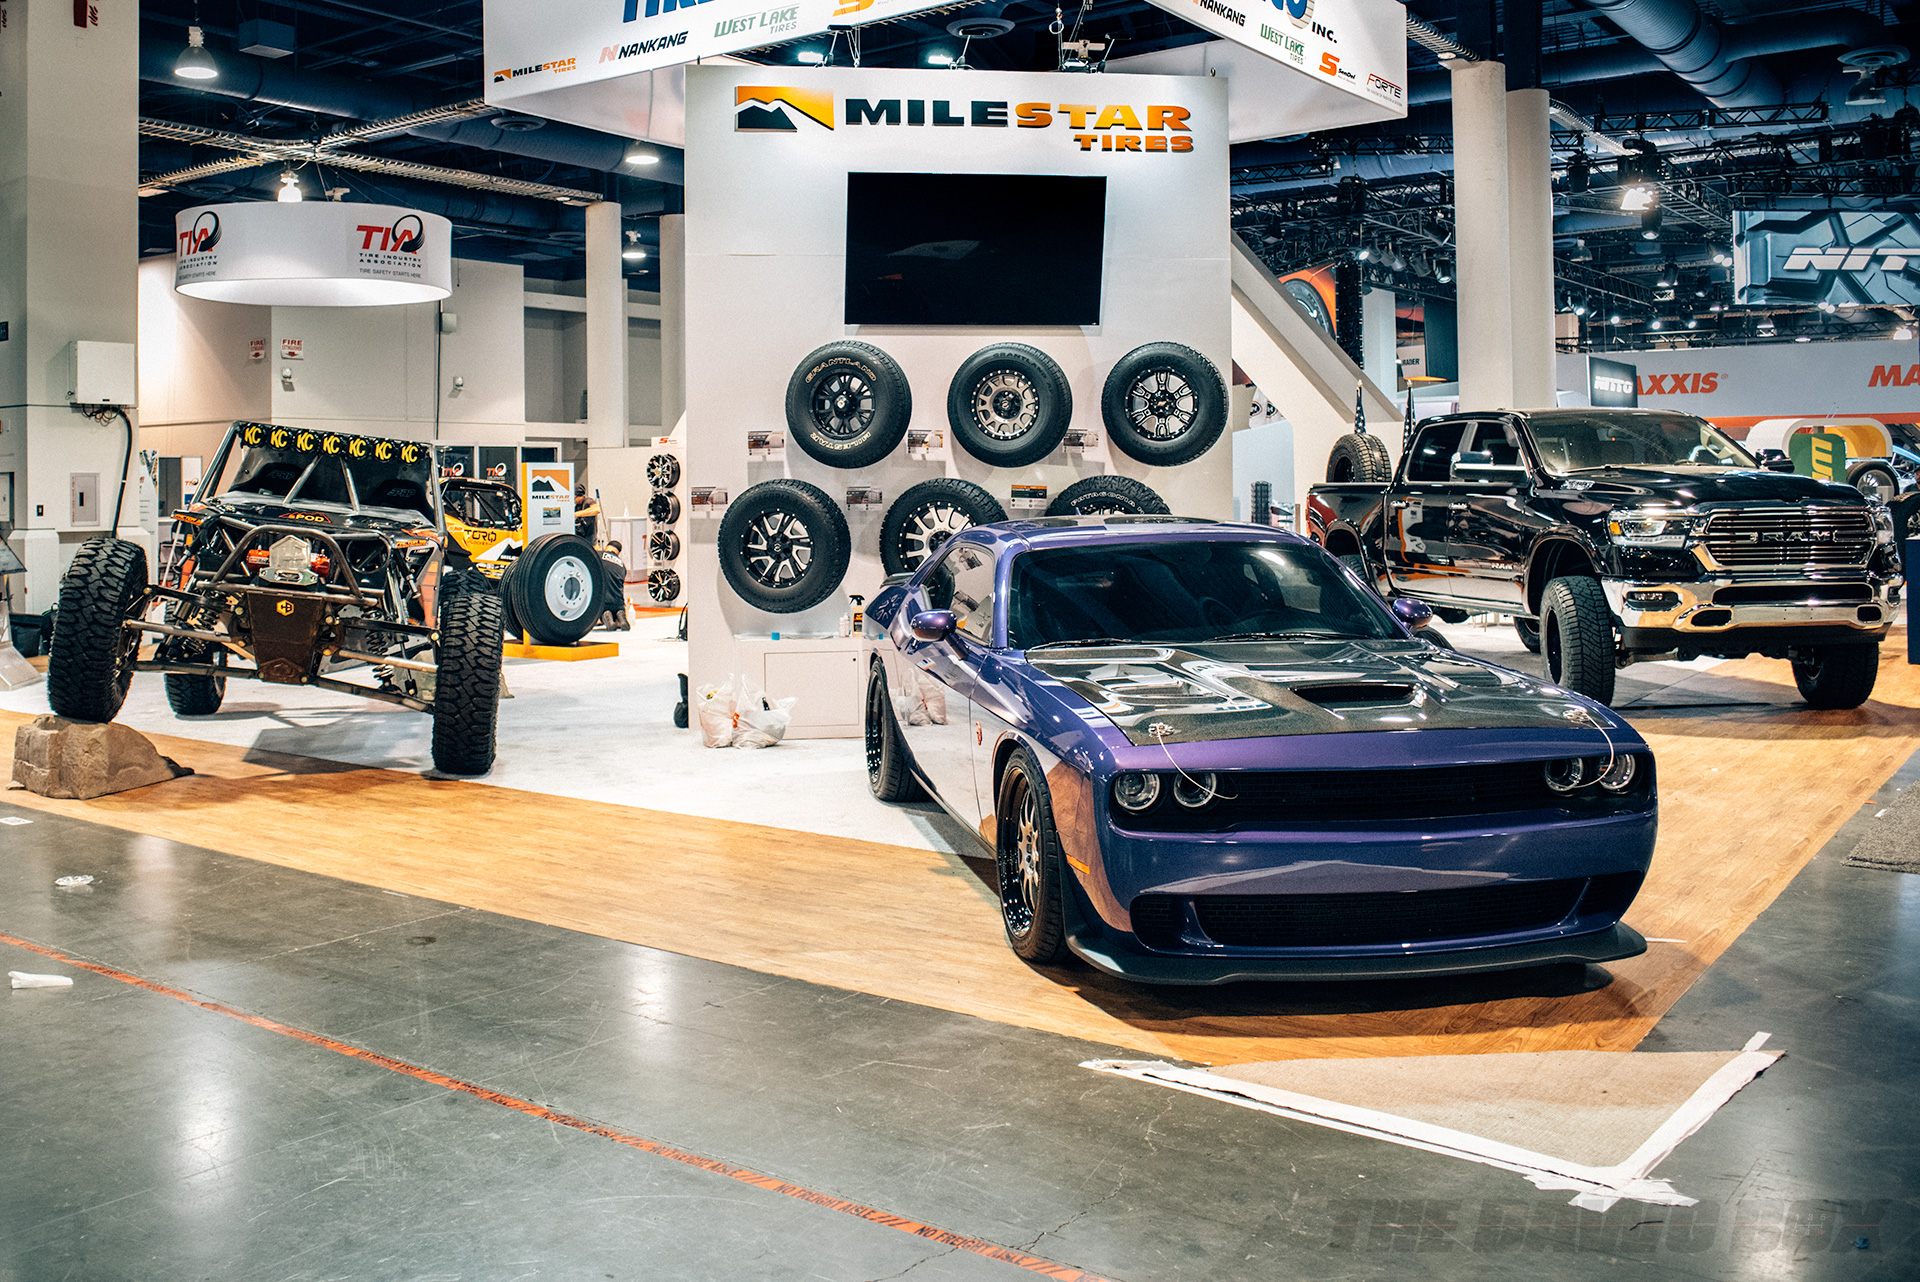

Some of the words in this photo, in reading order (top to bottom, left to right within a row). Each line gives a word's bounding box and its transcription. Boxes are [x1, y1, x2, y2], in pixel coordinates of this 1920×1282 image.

[714, 16, 756, 38] WEST
[759, 6, 799, 28] LAKE
[770, 21, 797, 35] TIRES
[1311, 21, 1338, 43] INC.
[618, 30, 689, 60] NANKANG
[1260, 23, 1283, 47] WEST
[1285, 36, 1305, 57] LAKE
[512, 57, 576, 77] MILESTAR
[553, 65, 577, 74] TIRES
[1366, 73, 1402, 99] FORTE
[846, 98, 1193, 131] MILESTAR
[1074, 133, 1194, 154] TIRES
[356, 225, 418, 255] TIA
[383, 254, 422, 262] INDUSTRY
[244, 426, 262, 445] KC
[270, 429, 288, 448] KC
[296, 432, 314, 451] KC
[323, 435, 340, 454] KC
[349, 438, 367, 458] KC
[375, 441, 392, 461] KC
[401, 444, 418, 463] KC
[464, 529, 497, 543] TORQ
[1762, 531, 1830, 541] RAM
[774, 1183, 796, 1194] NO
[794, 1189, 843, 1210] FREIGHT
[838, 1204, 876, 1220] AISLE
[914, 1225, 938, 1238] NO
[934, 1232, 990, 1253] FREIGHT
[987, 1247, 1029, 1266] AISLE
